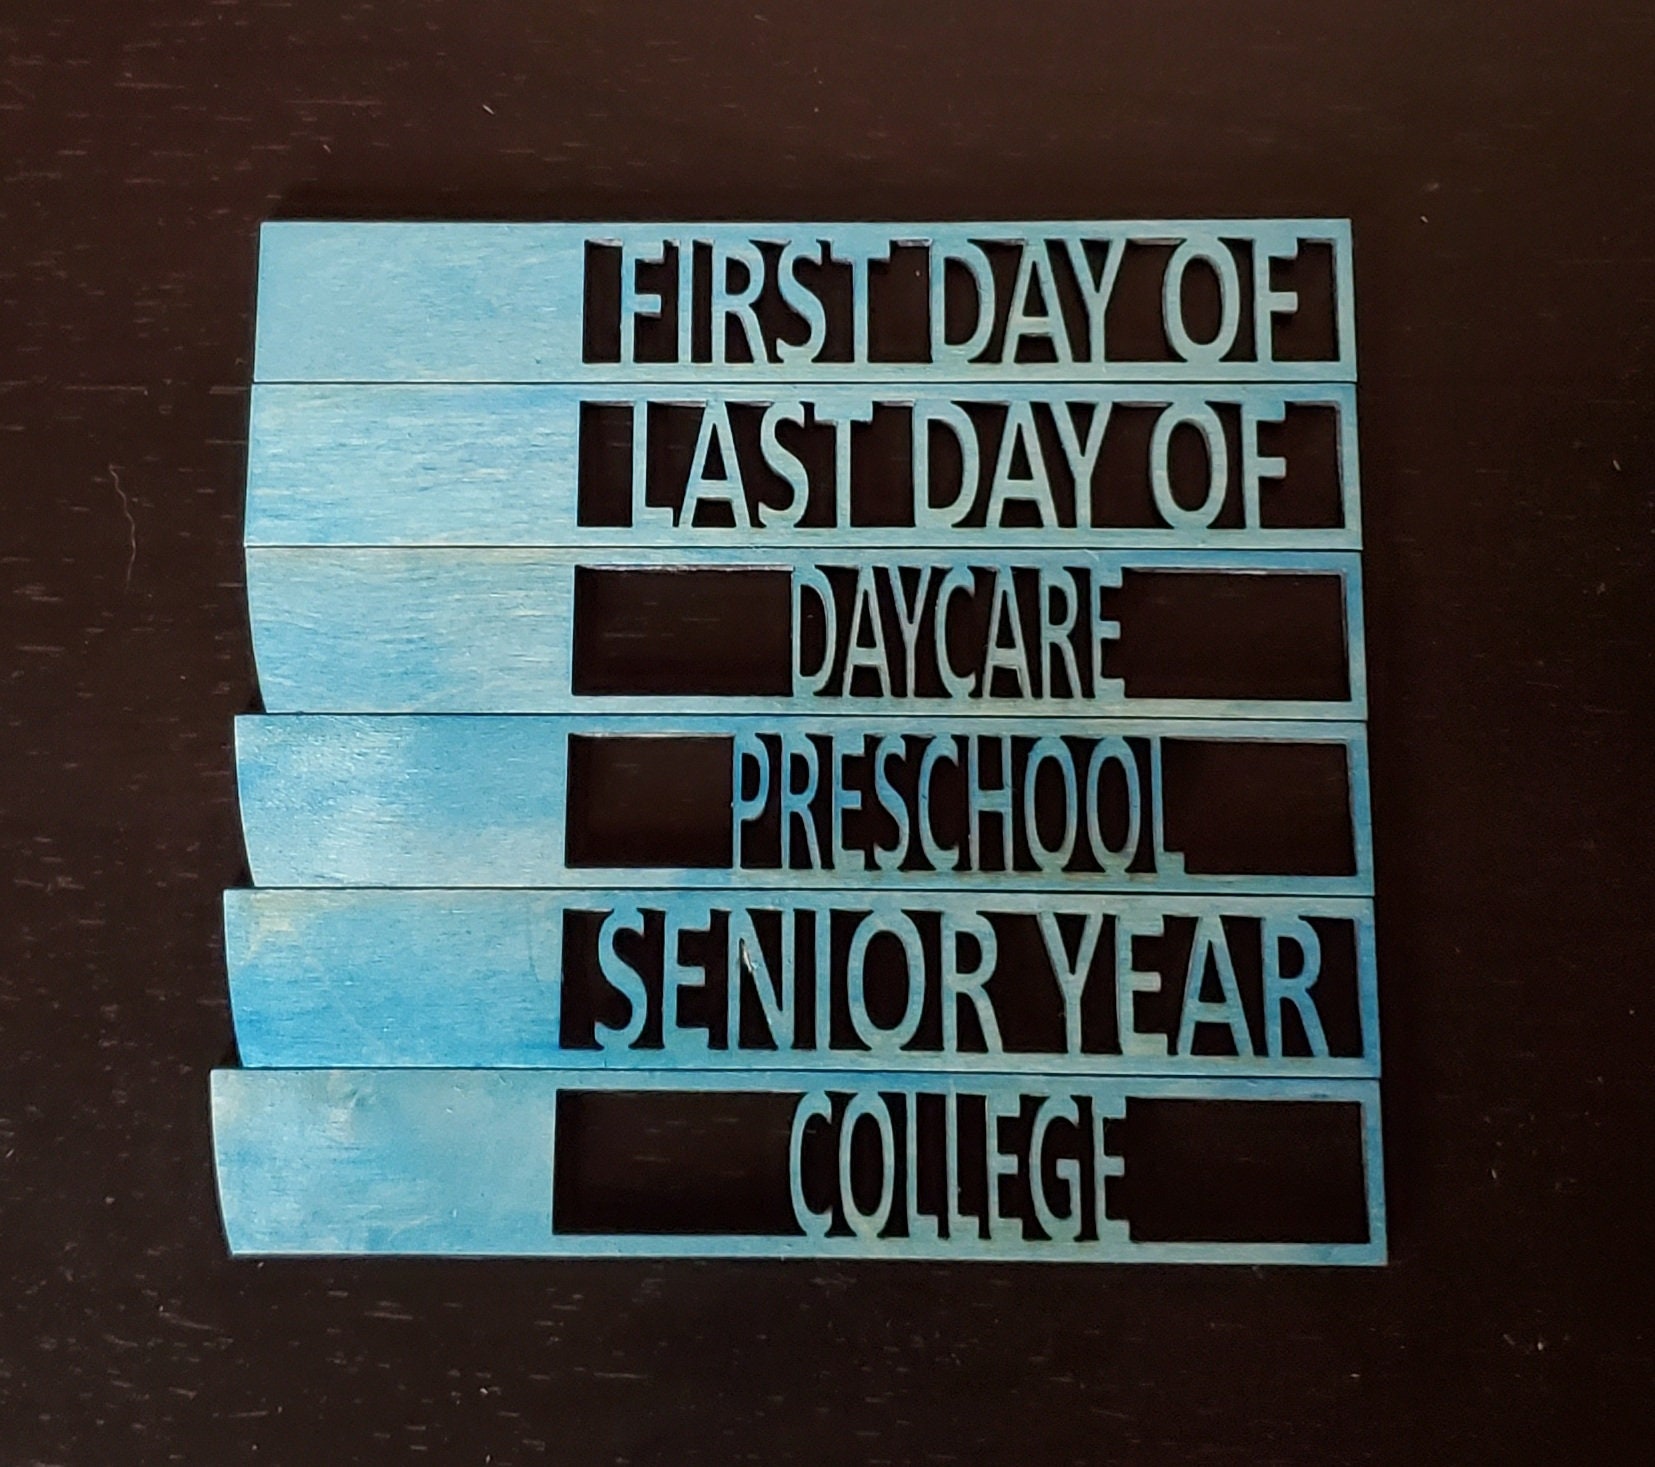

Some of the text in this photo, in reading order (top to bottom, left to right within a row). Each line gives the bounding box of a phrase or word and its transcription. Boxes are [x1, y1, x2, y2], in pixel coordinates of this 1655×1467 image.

[617, 239, 1298, 363] FIRST DAY OF
[630, 401, 1286, 530] LAST DAY OF
[791, 567, 1126, 698] DAYCARE
[731, 733, 1186, 874] PRESCHOOL
[593, 908, 1328, 1058] SENIOR YEAR
[790, 1092, 1130, 1240] COLLEGE
